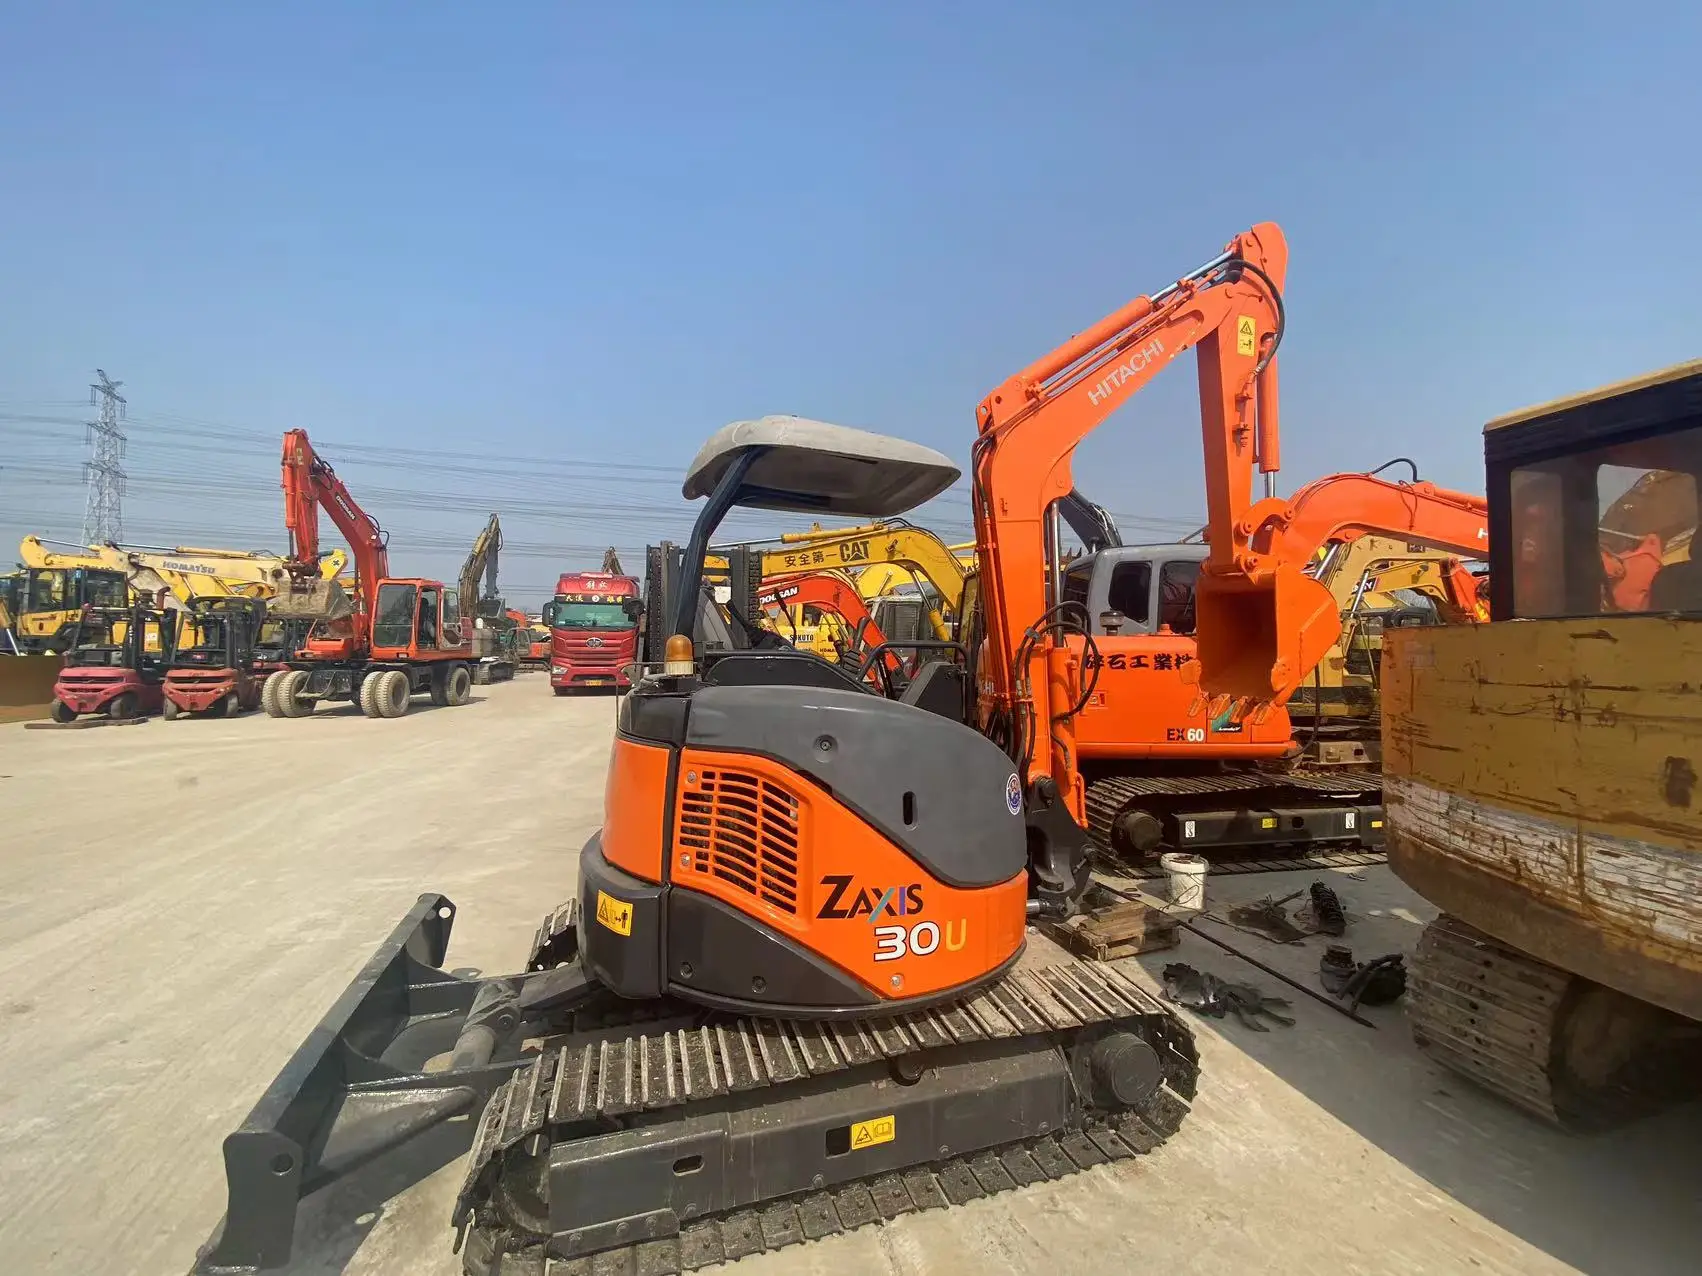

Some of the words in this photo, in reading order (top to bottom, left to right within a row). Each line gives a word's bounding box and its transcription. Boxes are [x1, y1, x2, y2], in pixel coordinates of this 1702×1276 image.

[1087, 337, 1165, 406] HITACHI
[784, 551, 837, 568] 安全第一
[840, 540, 870, 562] CAT
[162, 561, 216, 574] KOMATSU
[816, 875, 924, 923] ZAXIS
